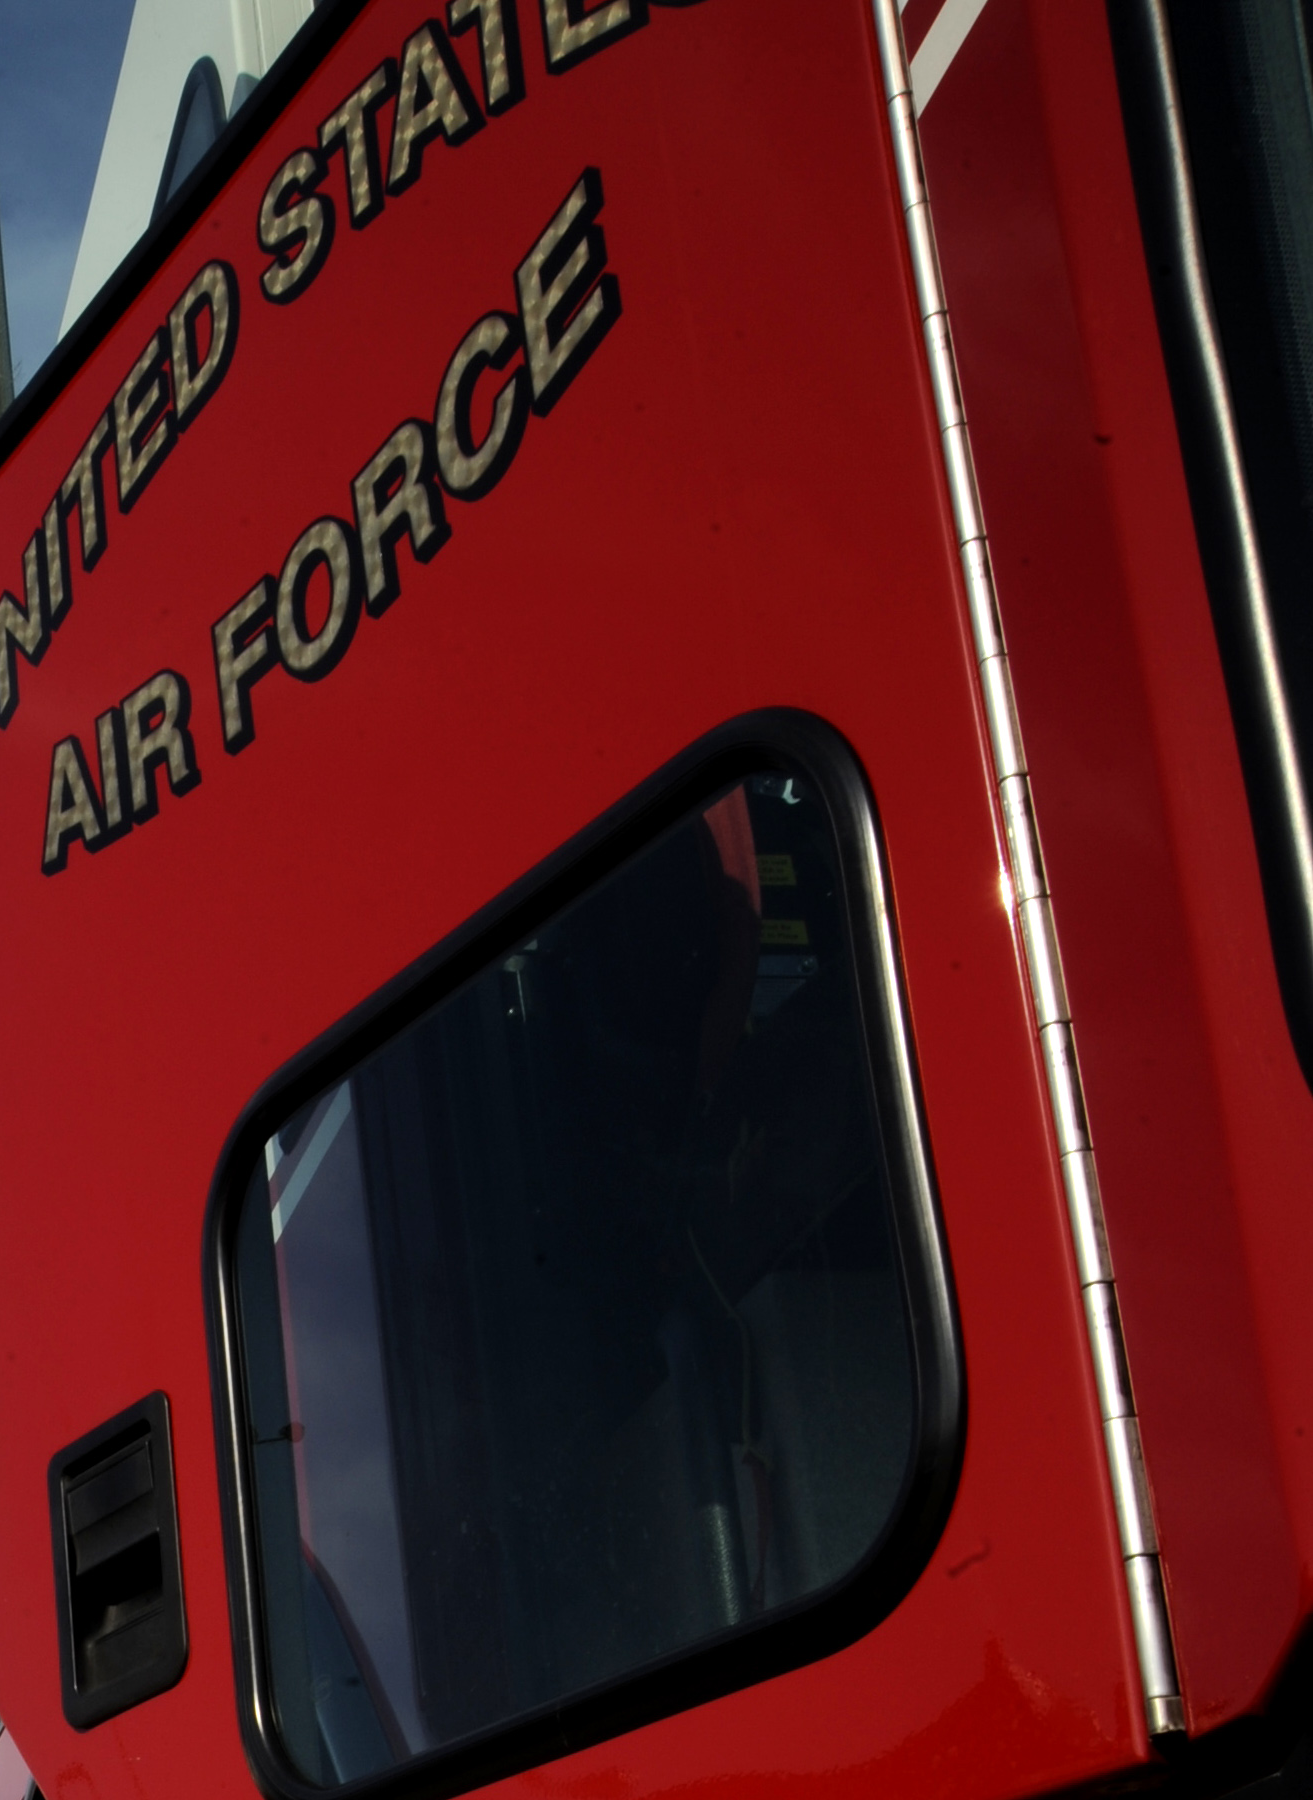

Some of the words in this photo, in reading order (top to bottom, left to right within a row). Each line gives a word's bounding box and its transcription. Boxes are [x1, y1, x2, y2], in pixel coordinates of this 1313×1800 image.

[256, 0, 706, 305] STAT
[41, 668, 202, 876] AIR
[211, 166, 622, 756] FORCE
